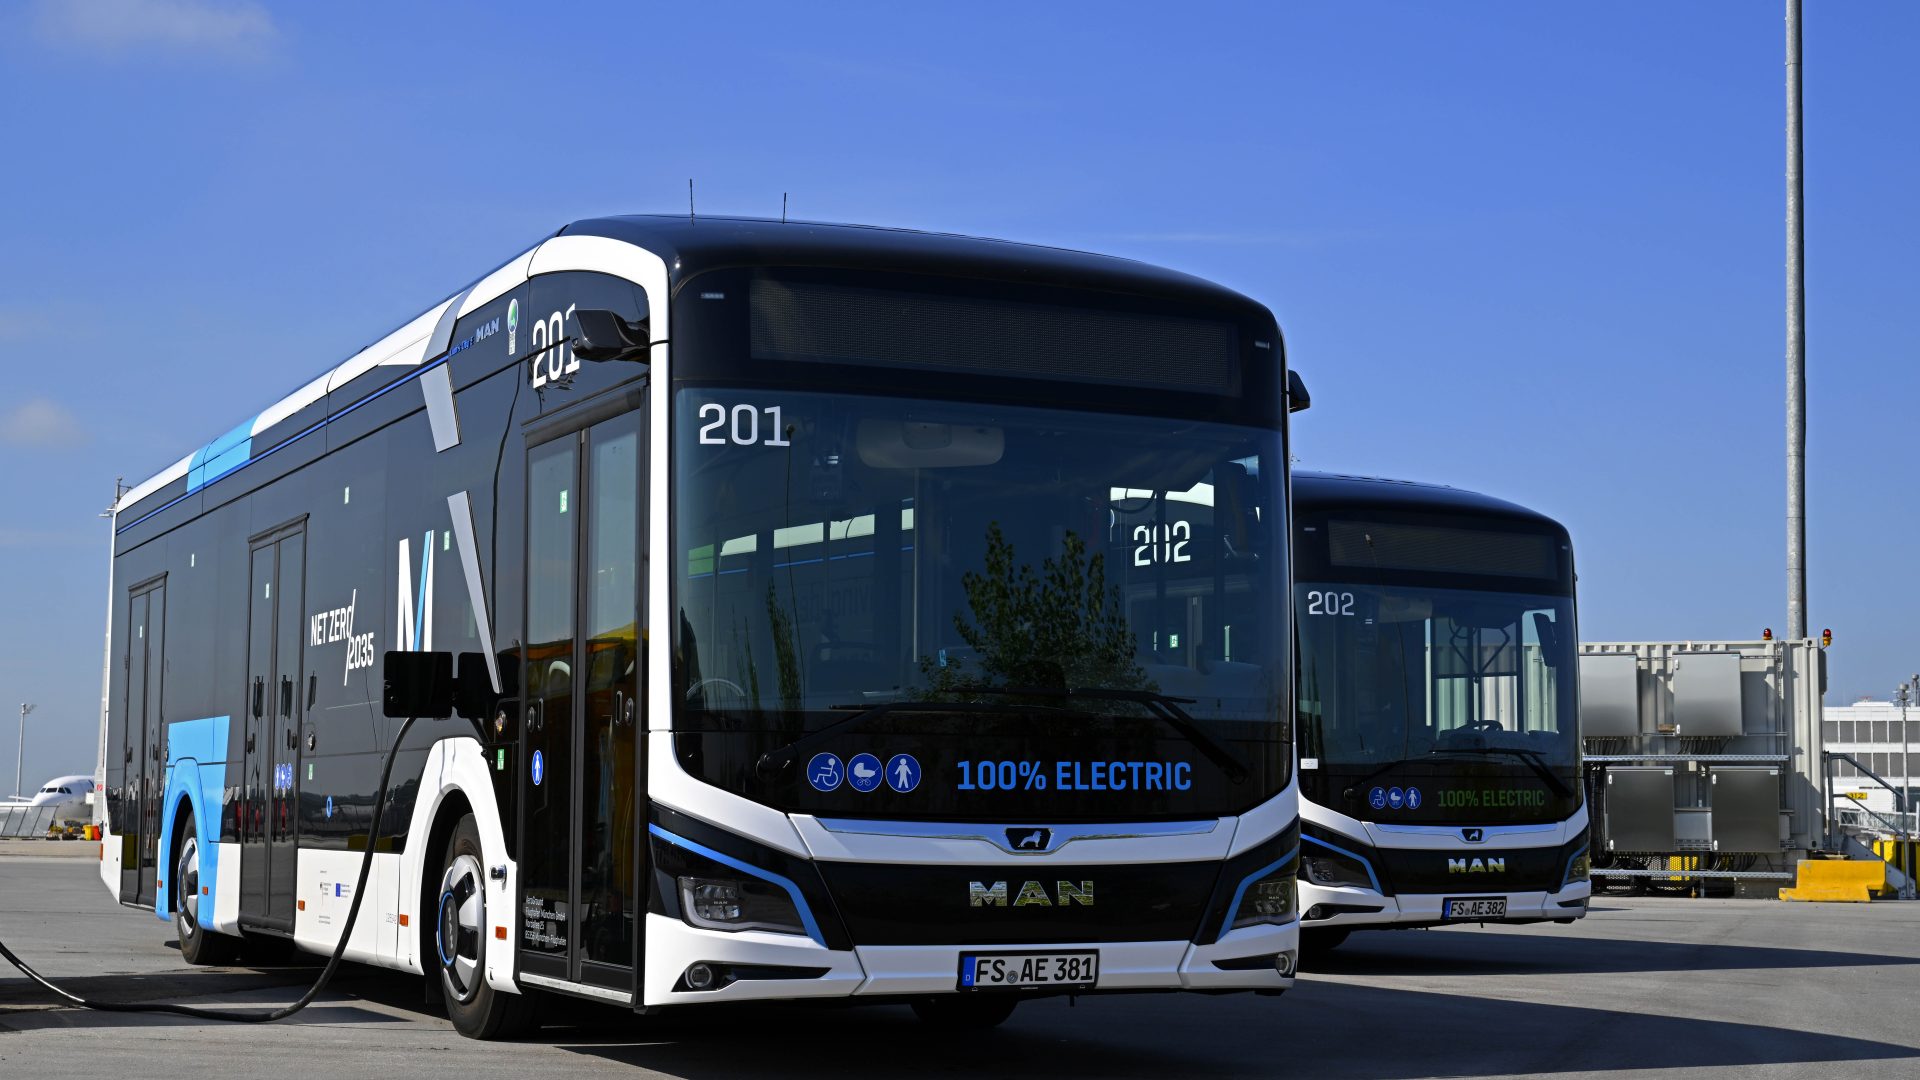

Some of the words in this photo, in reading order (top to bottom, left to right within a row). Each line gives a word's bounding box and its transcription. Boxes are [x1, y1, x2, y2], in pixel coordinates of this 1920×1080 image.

[475, 317, 500, 343] MAN
[699, 403, 791, 447] 201
[1133, 520, 1191, 567] 202
[1307, 590, 1355, 616] 202
[310, 611, 328, 647] NET
[957, 760, 1047, 791] 100%
[1056, 761, 1192, 791] ELECTRIC
[1437, 789, 1479, 807] 100%
[1482, 789, 1545, 807] ELECTRIC
[1447, 857, 1506, 874] MAN
[969, 880, 1095, 907] MAN
[1450, 902, 1465, 916] FS
[1470, 901, 1485, 915] AE
[1485, 901, 1505, 915] 382
[976, 959, 1006, 983] FS
[1020, 957, 1049, 982] AE
[1053, 957, 1094, 981] 381
